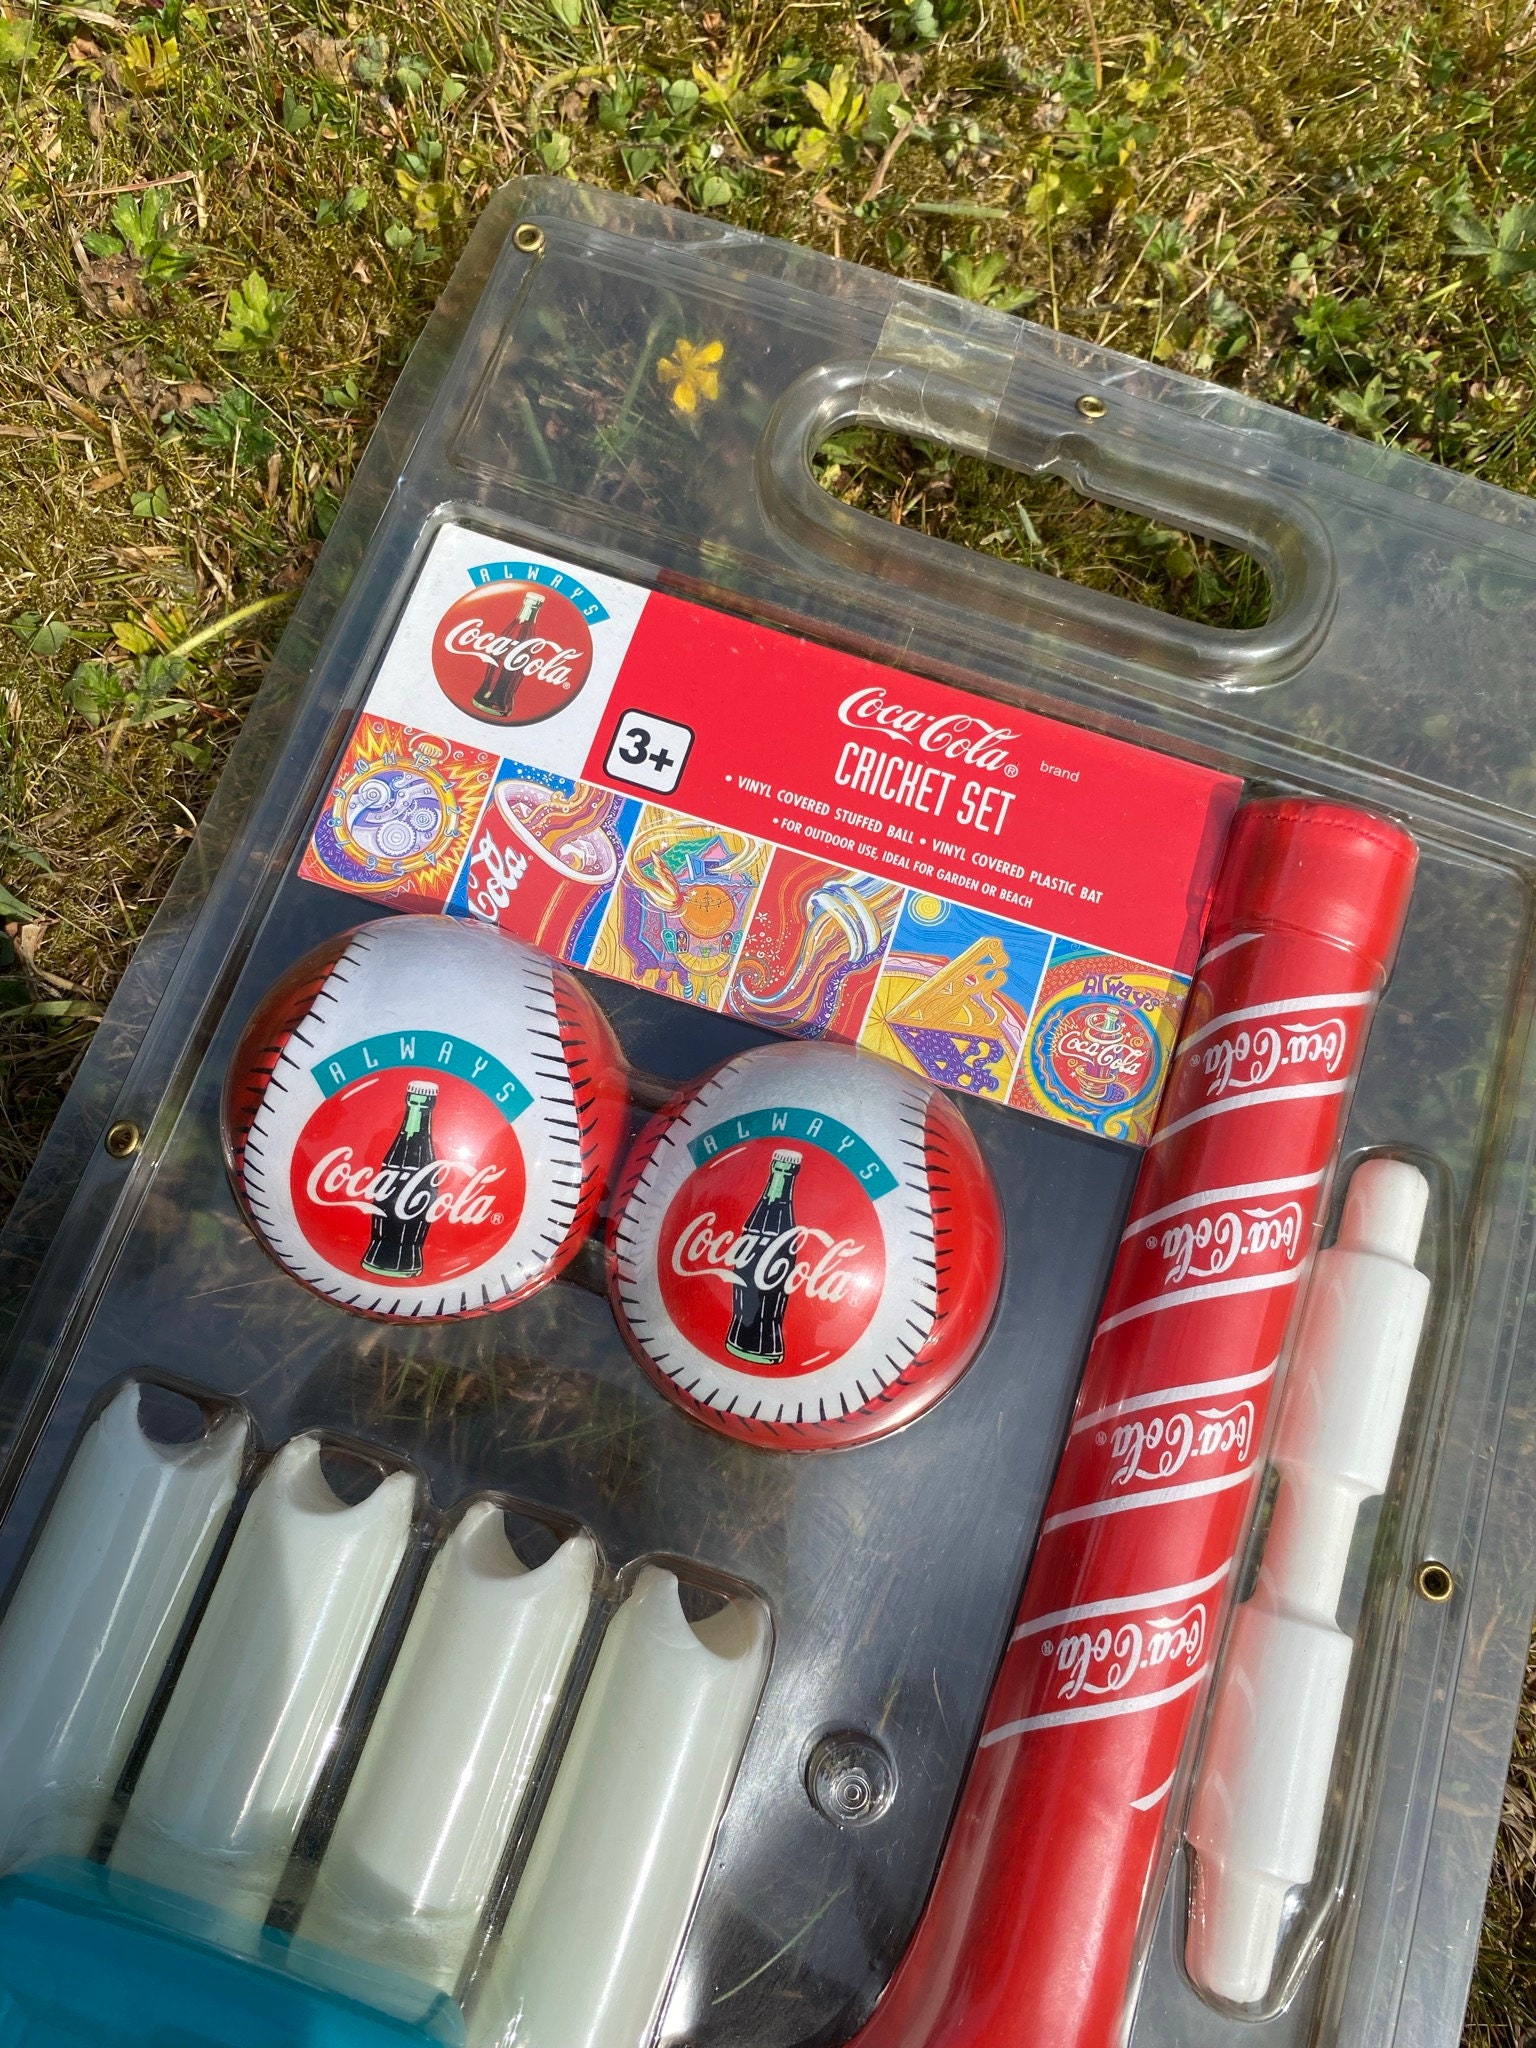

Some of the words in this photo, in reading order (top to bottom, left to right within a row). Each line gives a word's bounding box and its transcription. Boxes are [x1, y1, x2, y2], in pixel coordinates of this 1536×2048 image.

[480, 565, 599, 616] ALWAYS
[353, 758, 370, 776] 10
[382, 751, 397, 766] 11
[412, 753, 432, 770] 12
[617, 726, 675, 772] 3+
[1039, 760, 1081, 783] brand
[834, 742, 956, 816] CRICKET
[956, 781, 1016, 836] SET
[738, 775, 772, 799] VINYL
[776, 789, 831, 816] COVERED
[834, 807, 883, 833] STUFFED
[887, 824, 914, 844] BALL
[932, 838, 966, 861] VINYL
[971, 852, 1025, 879] COVERED
[1029, 870, 1076, 896] PLASTIC
[1079, 886, 1103, 904] BAT
[780, 817, 802, 834] FOR
[804, 825, 855, 851] OUTDOOR
[857, 842, 879, 861] USE,
[881, 850, 910, 870] IDEAL
[912, 860, 934, 877] FOR
[936, 868, 979, 891] GARDEN
[981, 882, 998, 897] OR
[999, 888, 1033, 909] BEACH
[1081, 973, 1161, 1012] Always
[328, 1036, 516, 1103] ALWAYS
[703, 1112, 880, 1180] ALWAYS
